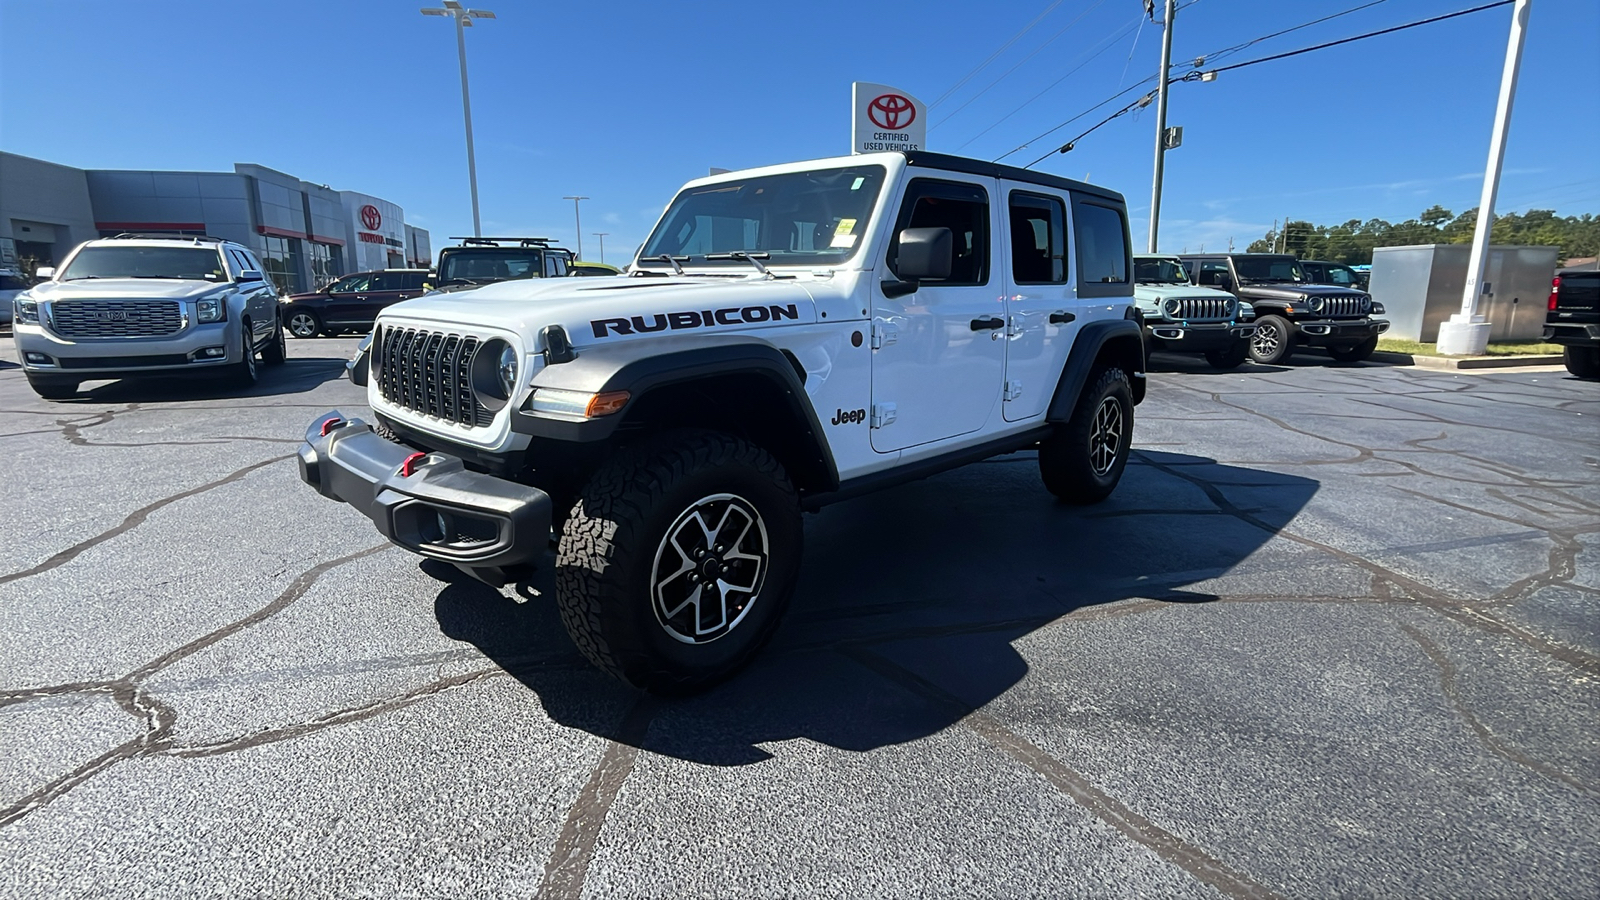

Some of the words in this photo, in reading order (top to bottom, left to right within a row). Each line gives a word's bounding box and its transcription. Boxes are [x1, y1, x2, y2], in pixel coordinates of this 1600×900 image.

[873, 132, 909, 142] CERTIFIED
[864, 142, 883, 151] USED
[885, 143, 918, 151] VEHICLES
[358, 231, 385, 245] TOYOTA
[93, 310, 141, 320] GMC
[590, 304, 799, 338] RUBICON
[831, 408, 866, 426] Jeep
